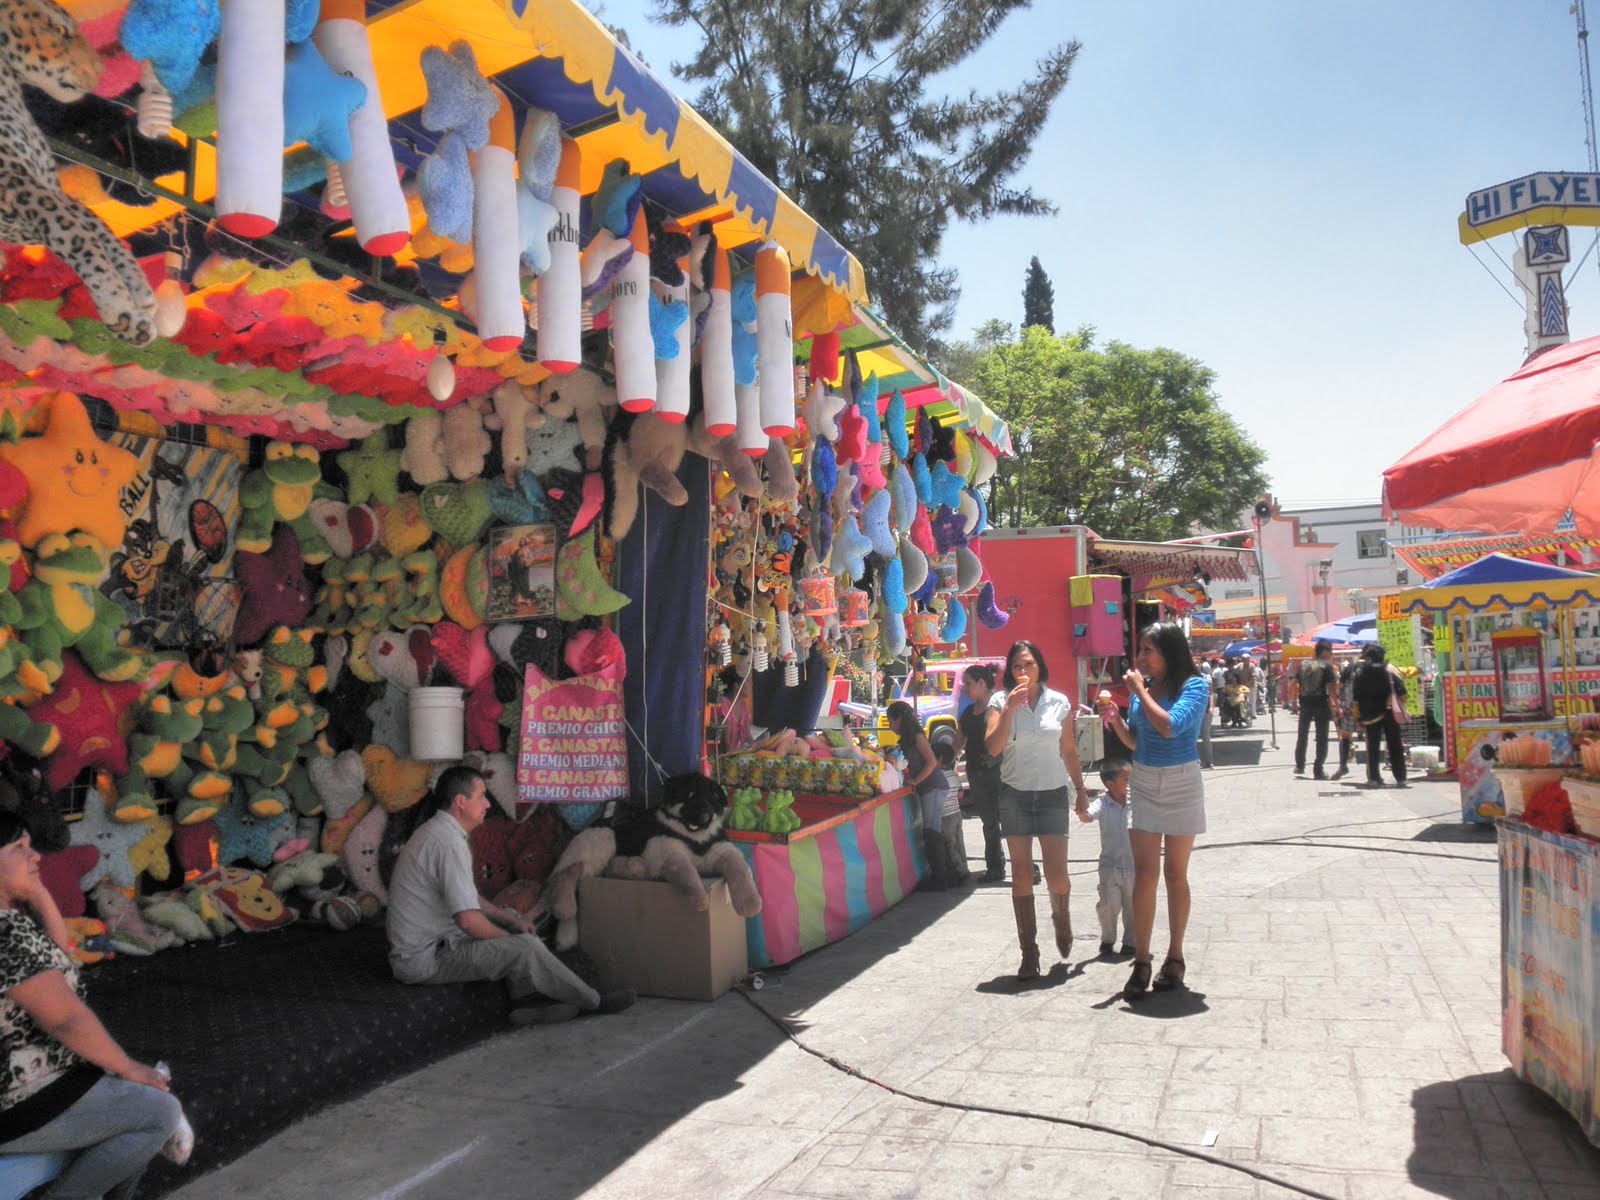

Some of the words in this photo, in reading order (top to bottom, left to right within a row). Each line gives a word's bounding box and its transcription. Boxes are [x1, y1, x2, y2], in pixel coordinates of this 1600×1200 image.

[1472, 190, 1502, 222] HI
[525, 704, 535, 719] 1
[527, 721, 582, 735] PREMIO
[522, 737, 533, 752] 2
[522, 753, 571, 768] PREMIO
[573, 754, 626, 768] MEDIANO
[519, 769, 530, 783] 3
[534, 769, 627, 784] CANASTAS
[518, 785, 570, 799] PREMIO
